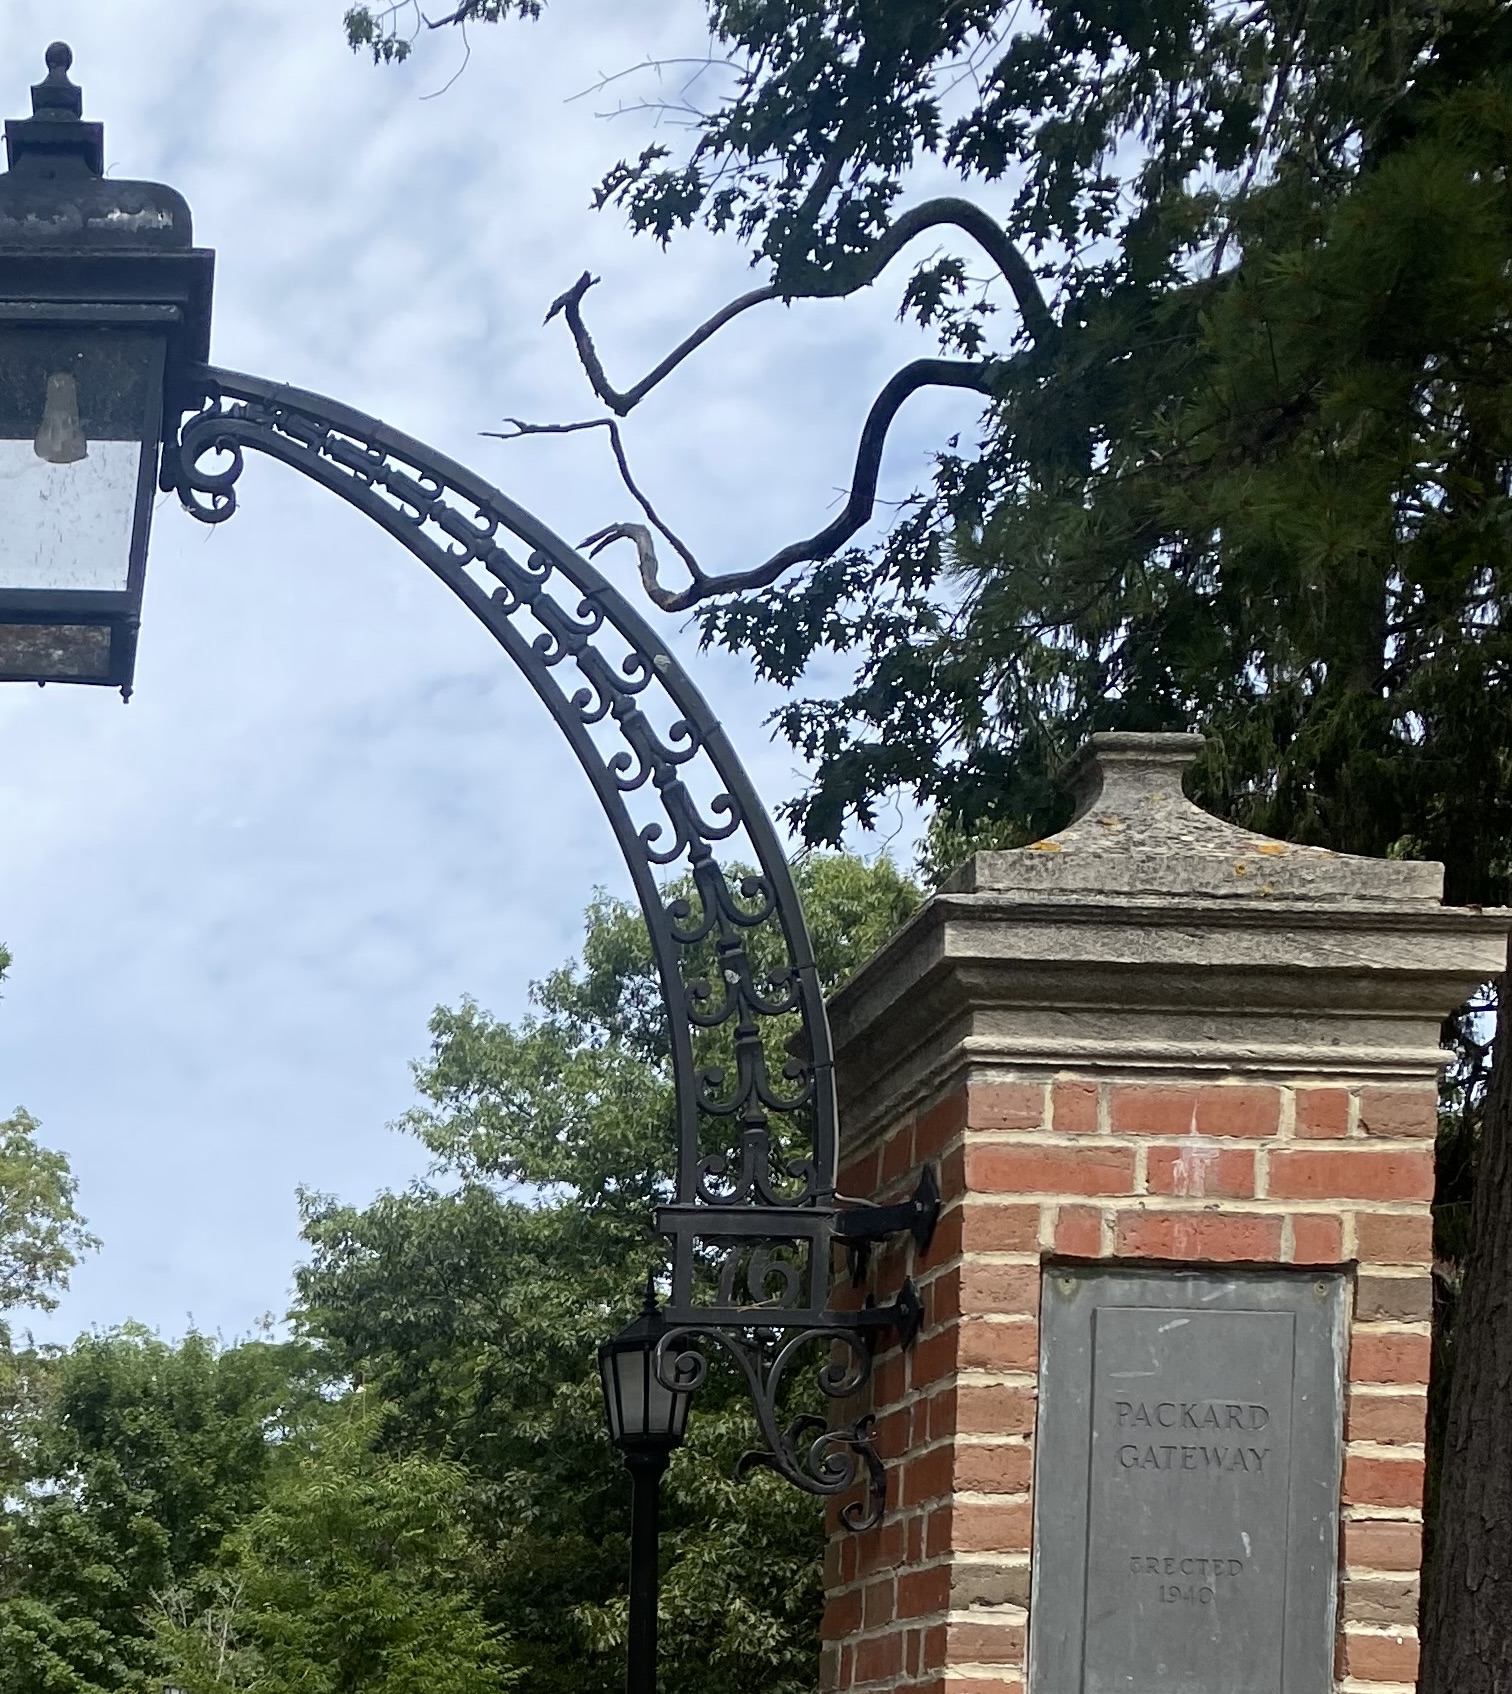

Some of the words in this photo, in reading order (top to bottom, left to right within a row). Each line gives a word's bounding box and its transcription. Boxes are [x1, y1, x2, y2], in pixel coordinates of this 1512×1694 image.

[1114, 1401, 1270, 1431] PACKARD
[1117, 1444, 1272, 1473] GATEWAY
[1129, 1556, 1244, 1577] ERECTED
[1159, 1584, 1214, 1605] 1940
